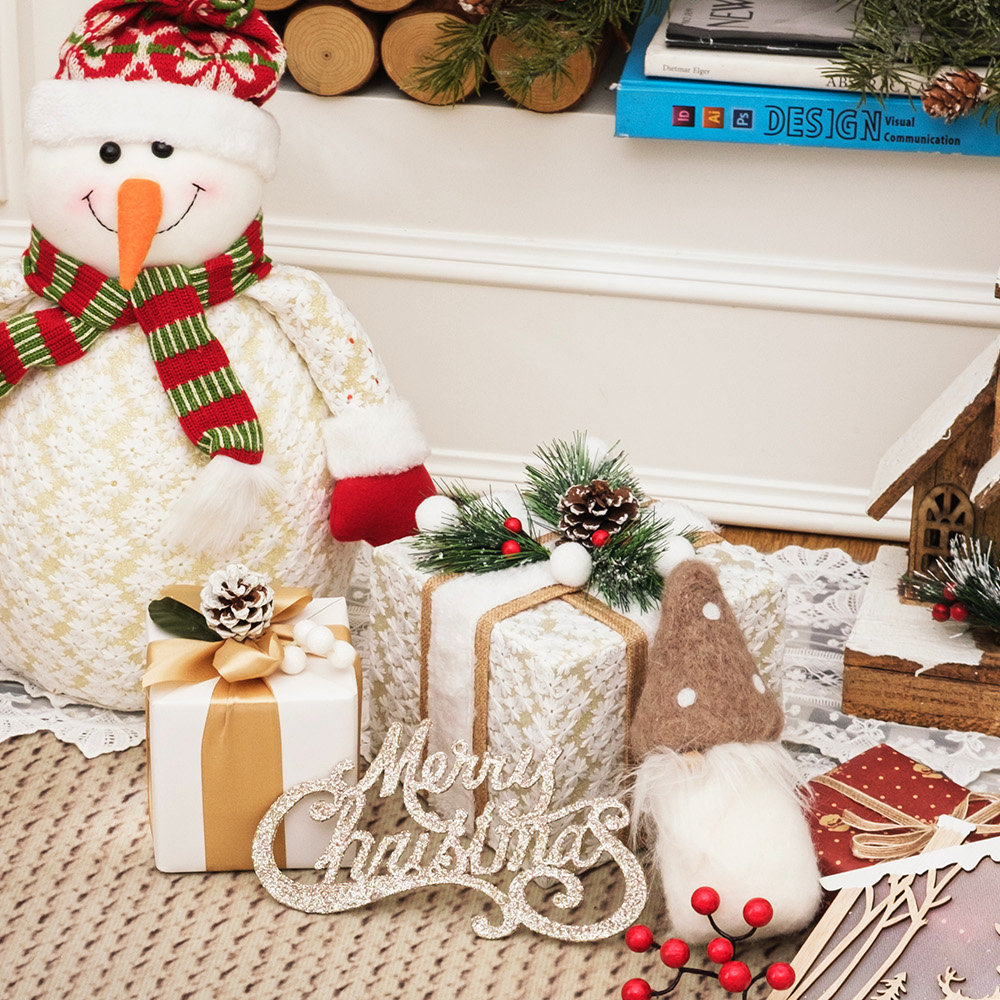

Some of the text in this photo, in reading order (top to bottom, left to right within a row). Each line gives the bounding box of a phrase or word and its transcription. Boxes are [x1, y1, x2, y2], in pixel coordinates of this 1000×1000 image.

[662, 64, 711, 76] Dietmar Elger
[708, 110, 721, 124] Ai
[736, 112, 749, 126] Ps
[763, 105, 882, 142] DESIGN
[885, 116, 915, 127] Visual
[884, 132, 961, 145] Communication
[354, 718, 563, 822] Merry
[252, 760, 648, 943] Christmas
